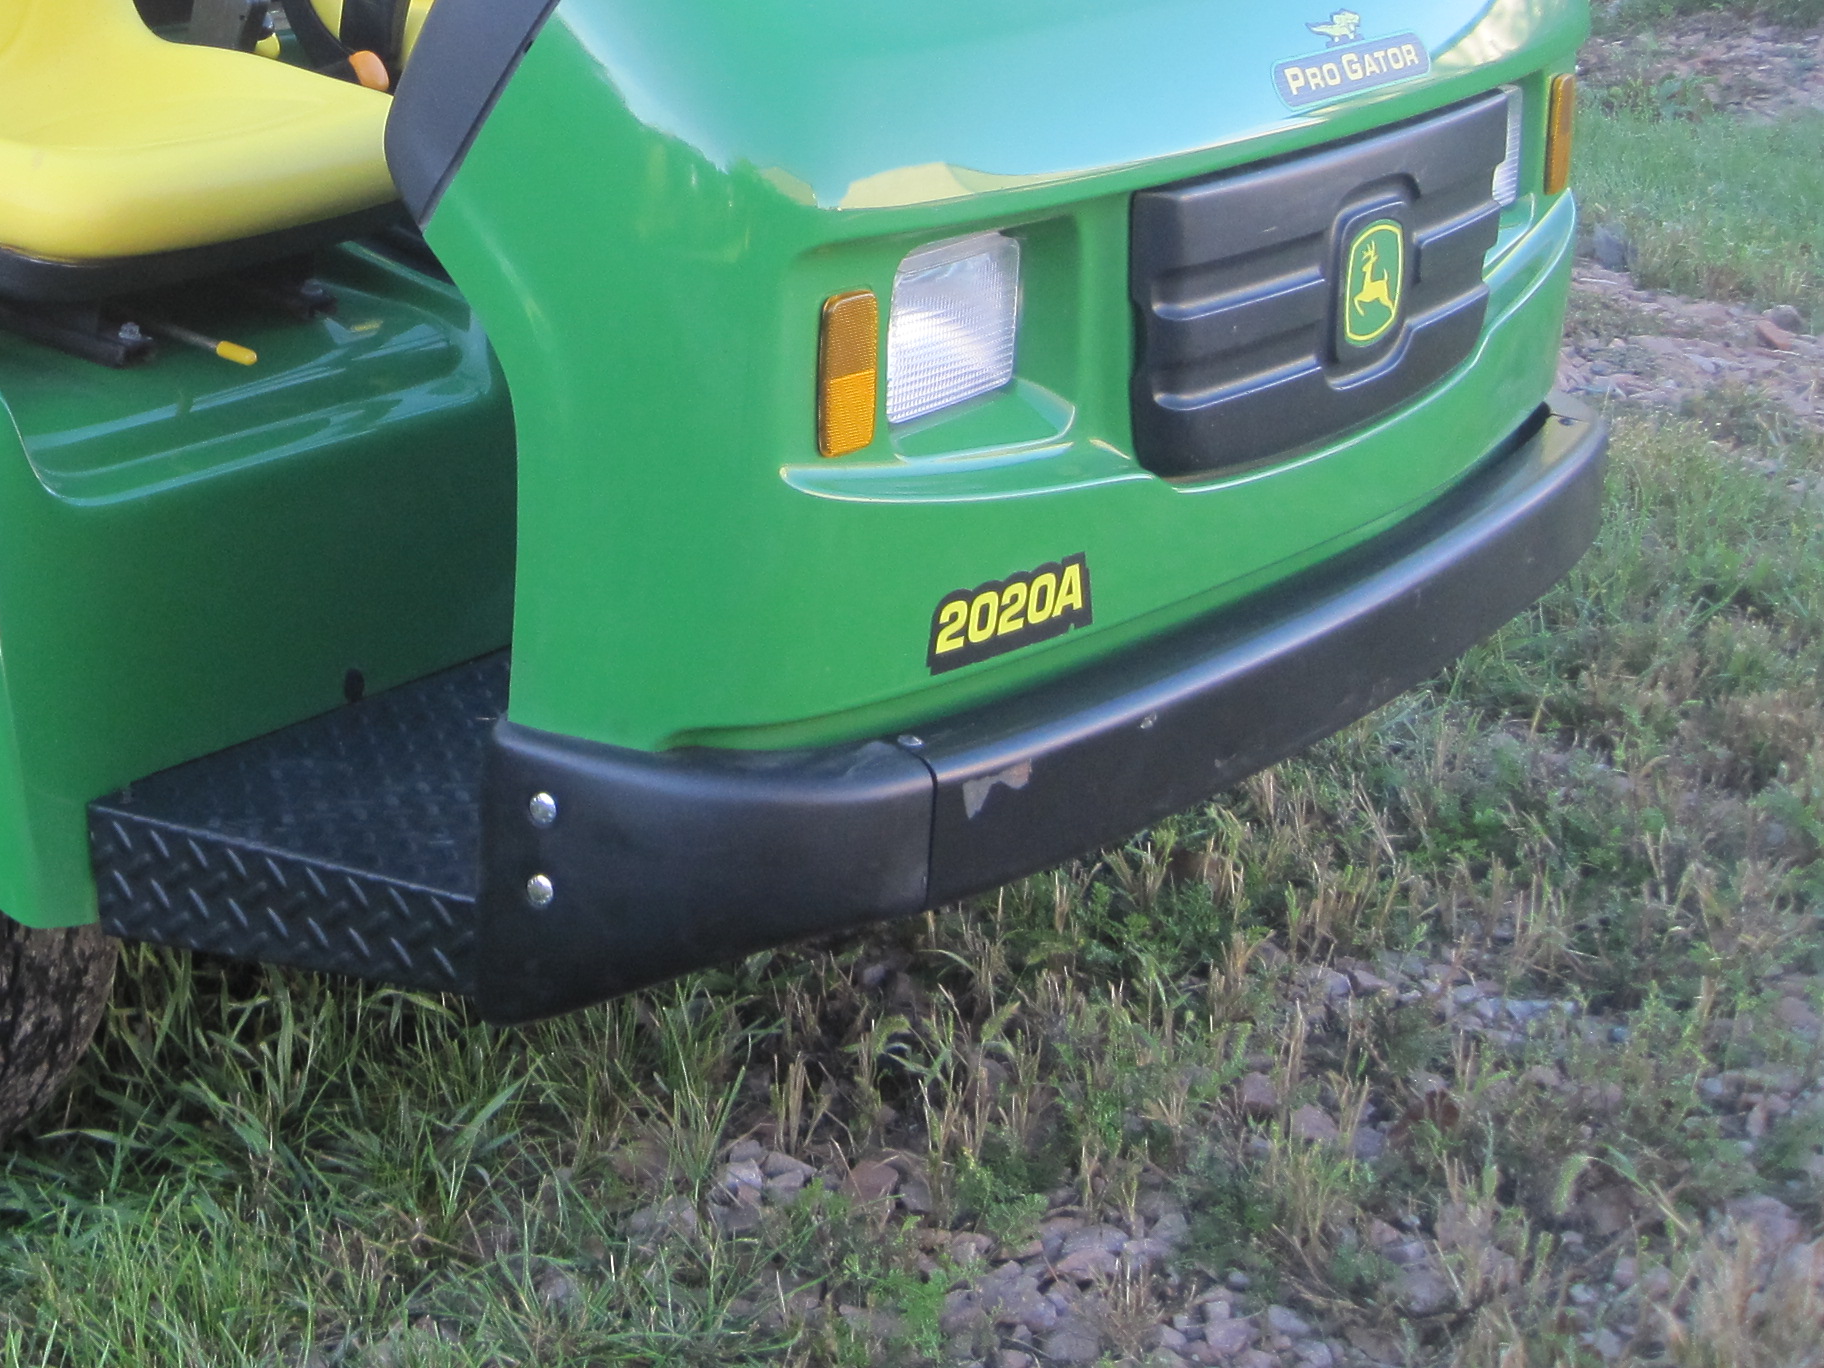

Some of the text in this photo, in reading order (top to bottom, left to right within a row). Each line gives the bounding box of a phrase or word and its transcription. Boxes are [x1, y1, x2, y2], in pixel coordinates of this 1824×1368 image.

[1283, 43, 1420, 96] PRO GATOR
[935, 563, 1083, 655] 2020A
